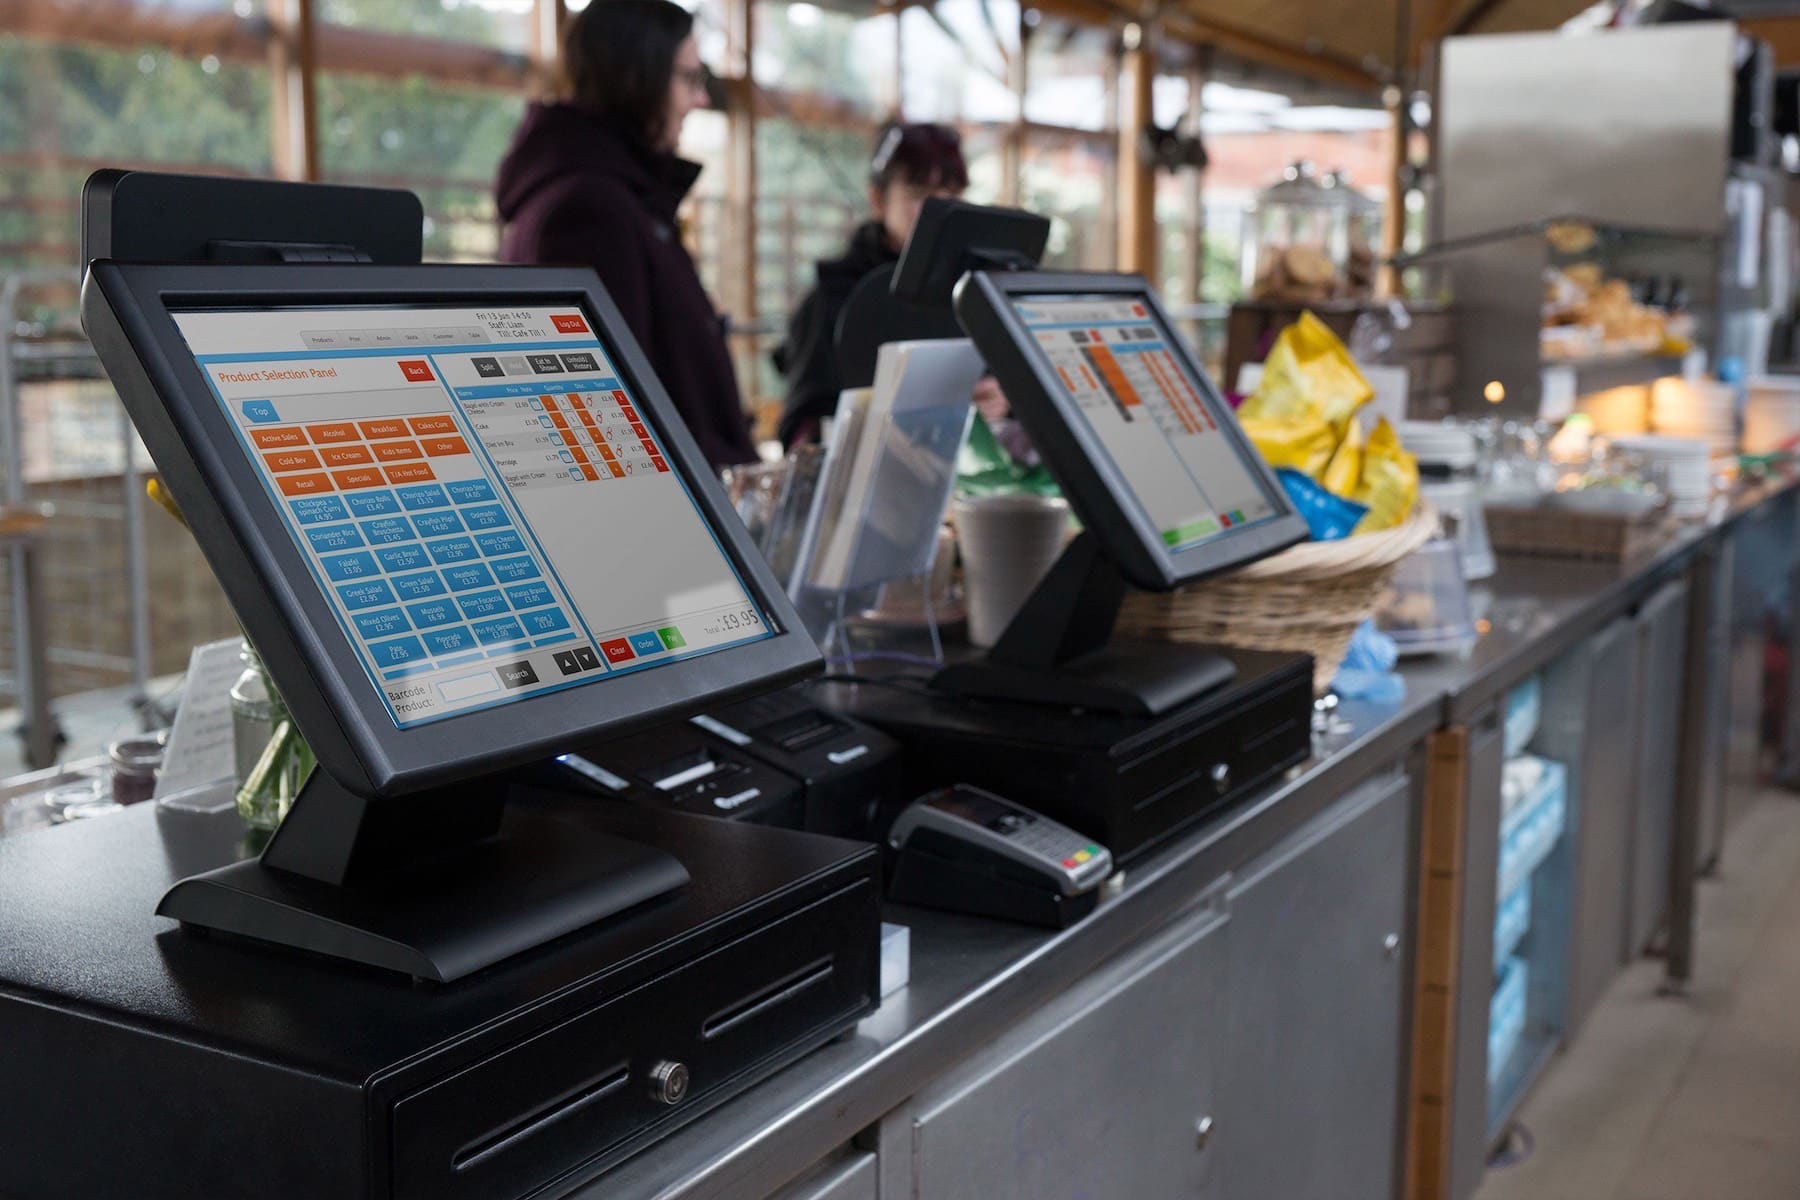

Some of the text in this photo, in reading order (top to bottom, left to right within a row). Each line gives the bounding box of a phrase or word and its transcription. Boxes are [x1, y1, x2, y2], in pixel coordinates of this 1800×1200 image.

[475, 312, 486, 321] Fri
[488, 312, 498, 320] 13
[508, 321, 525, 329] Liam
[558, 320, 581, 329] Log Out
[528, 329, 541, 337] Till
[535, 357, 545, 365] Eat
[218, 367, 338, 384] Product Selection Panel
[408, 367, 425, 375] Back
[252, 407, 269, 417] Top
[371, 425, 398, 433] Breakfast
[281, 433, 298, 441] Sales
[278, 457, 294, 465] Cold
[347, 474, 371, 483] Specials
[296, 481, 315, 489] Retail
[351, 497, 376, 506] Chorizo
[323, 505, 341, 514] Curry
[366, 503, 384, 511] £3.45
[314, 513, 333, 521] £4.95
[310, 532, 342, 541] Coriander
[383, 534, 401, 542] £3.45
[497, 535, 516, 543] Cheese
[328, 538, 346, 546] £2.05
[432, 544, 449, 553] Garlic
[384, 550, 419, 561] Garlic Bread
[447, 551, 464, 559] £2.95
[338, 559, 360, 567] Falafel
[397, 558, 415, 566] £2.50
[497, 561, 529, 571] Mixed Bread
[343, 567, 362, 575] £3.05
[400, 577, 434, 588] Green Salad
[346, 586, 383, 598] Greek Salad
[412, 585, 430, 594] £2.50
[360, 594, 378, 603] £2.95
[461, 599, 479, 608] Onion
[420, 606, 445, 615] Mussels
[360, 613, 400, 626] Mixed Olives
[428, 613, 445, 622] £6.99
[375, 623, 393, 632] £2.95
[638, 640, 654, 649] Order
[390, 651, 409, 660] £2.95
[610, 646, 626, 656] Clear
[506, 669, 529, 681] Search
[388, 686, 425, 701] Barcode
[395, 698, 435, 714] Product:
